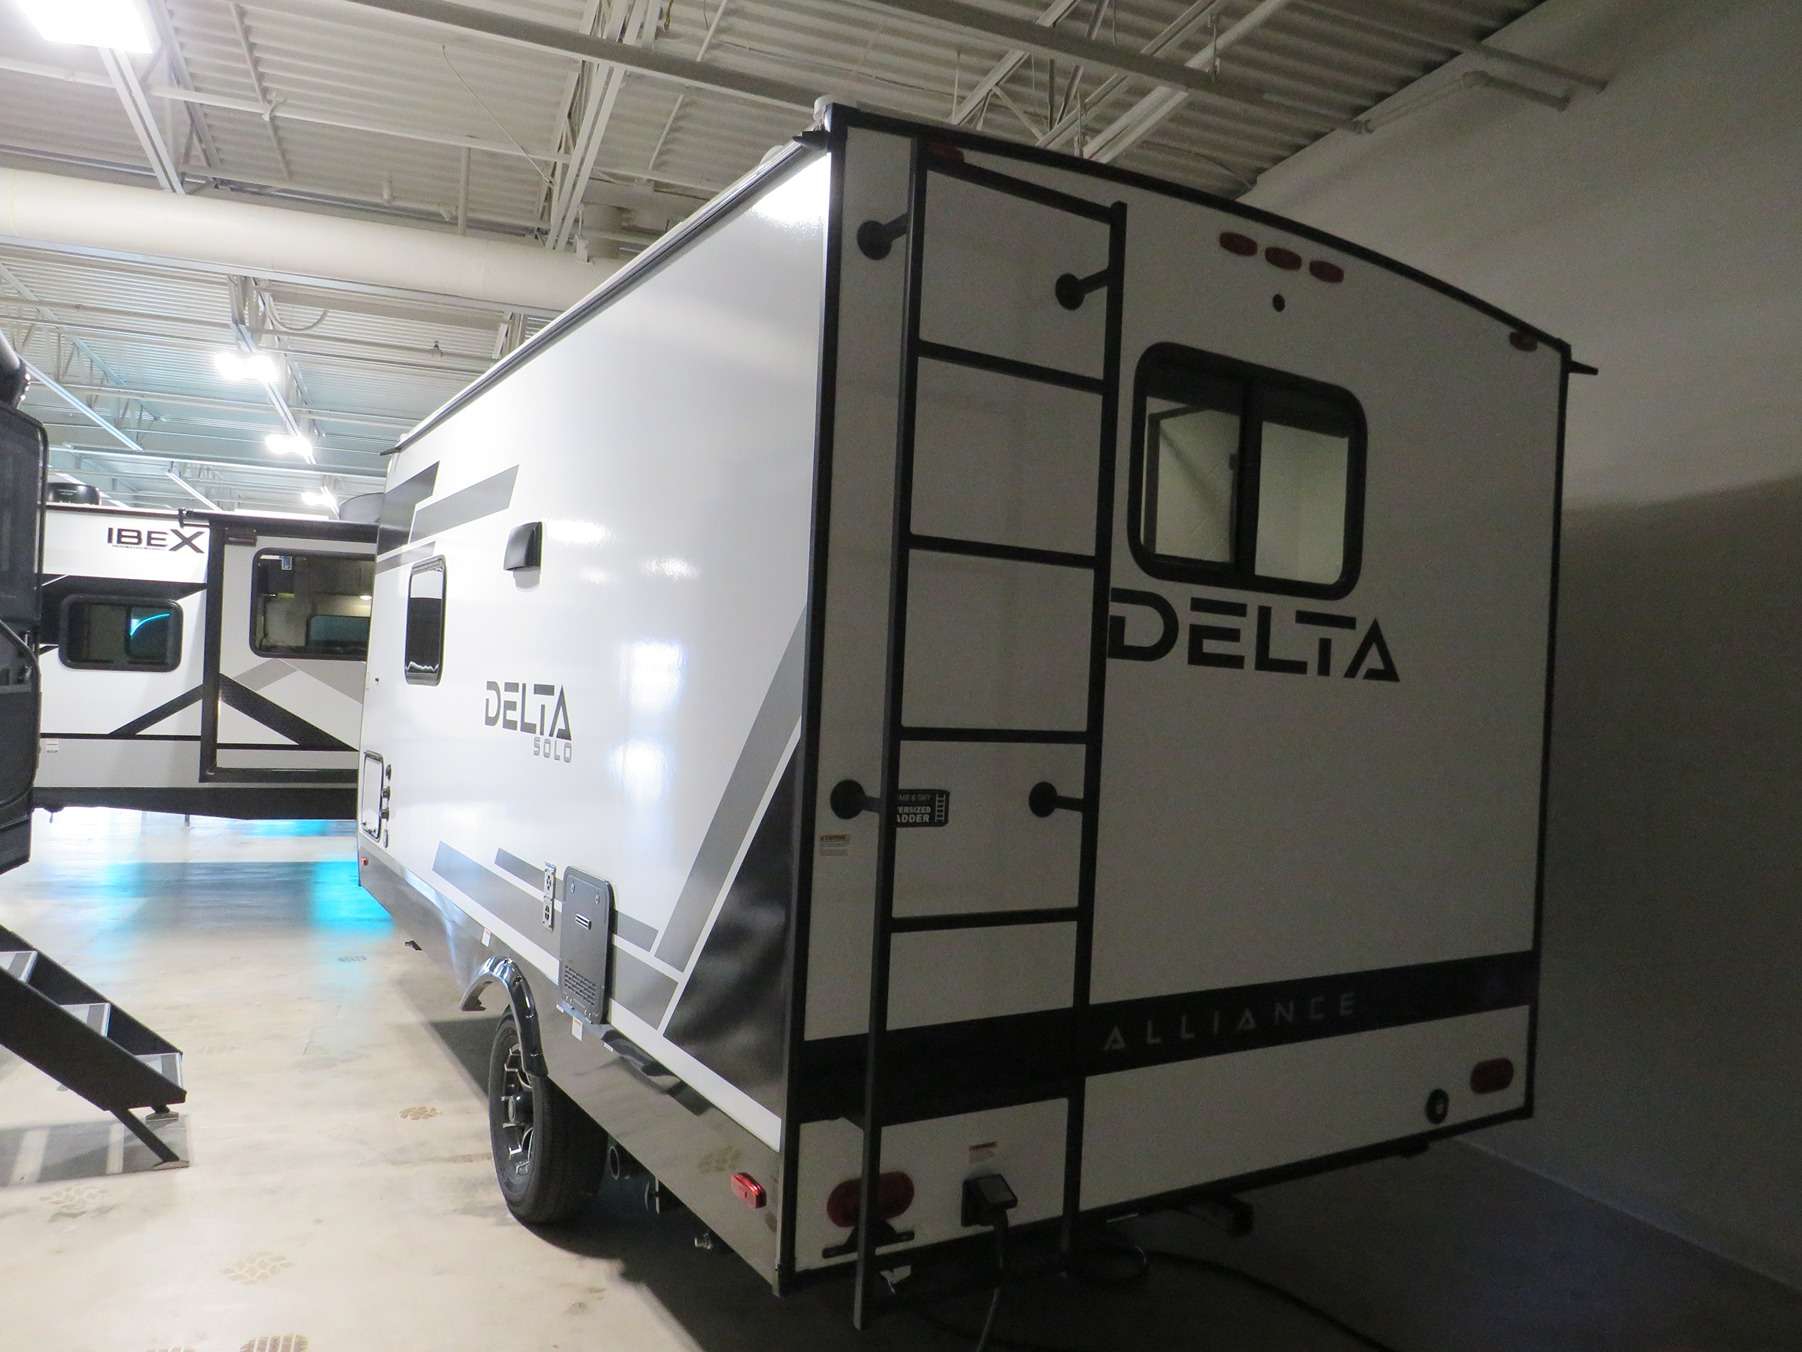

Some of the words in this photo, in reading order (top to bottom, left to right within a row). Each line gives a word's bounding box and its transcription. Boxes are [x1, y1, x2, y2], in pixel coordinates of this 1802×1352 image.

[107, 527, 205, 554] IBEX
[1107, 587, 1401, 682] DELTA
[484, 680, 572, 741] DELTA
[533, 736, 572, 763] SOLO
[1103, 992, 1356, 1051] ALLIANCE
